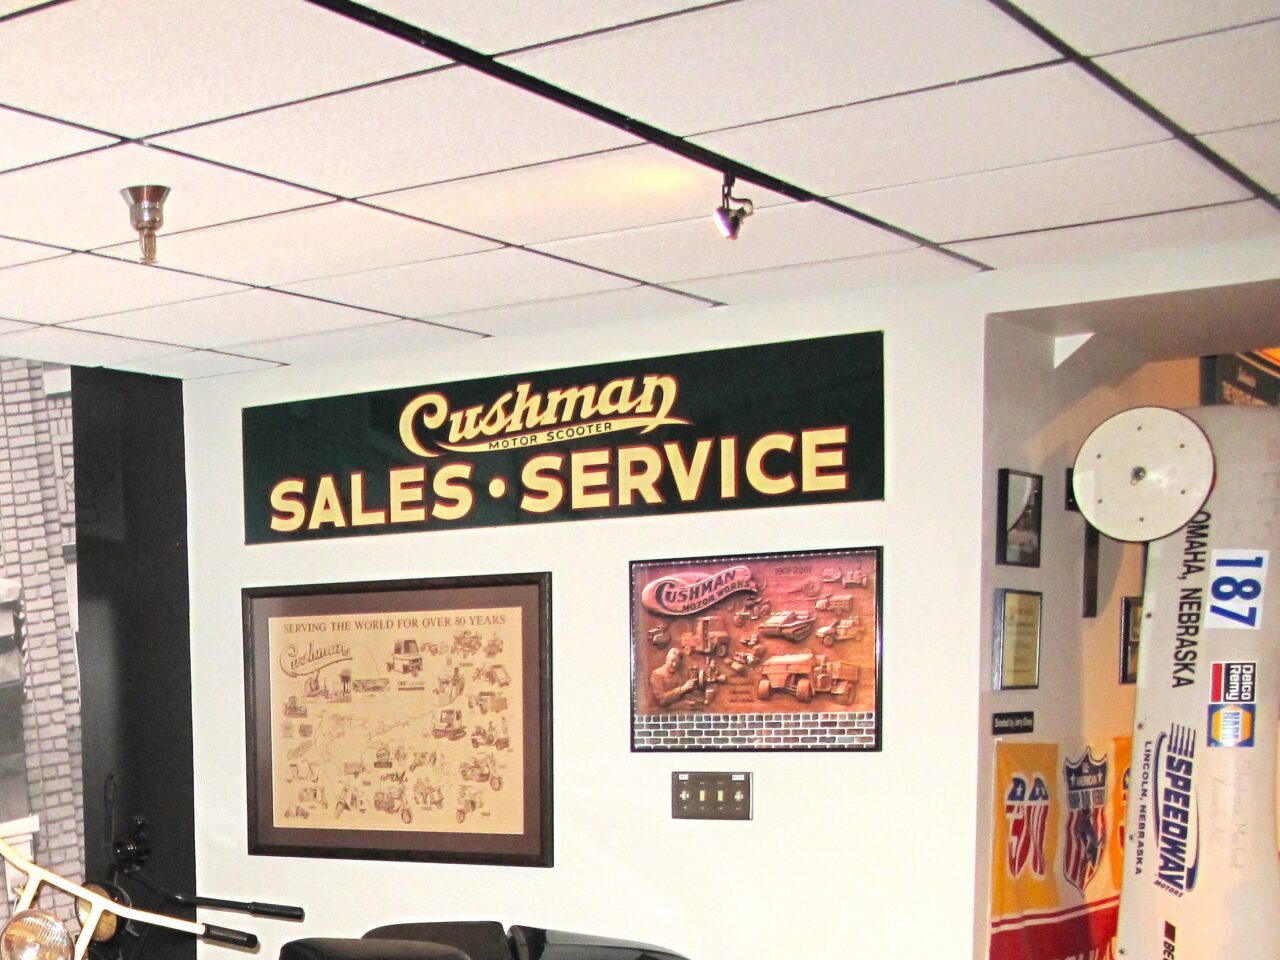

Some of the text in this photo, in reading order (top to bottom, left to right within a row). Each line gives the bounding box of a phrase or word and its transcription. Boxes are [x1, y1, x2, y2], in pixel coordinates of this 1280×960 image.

[399, 373, 693, 458] Cushman
[488, 421, 613, 450] MOTOR SCOOTER
[269, 426, 848, 532] SALES SERVICE
[654, 569, 738, 611] CUSHMAN
[681, 580, 751, 613] MOTOR WORKS
[1172, 510, 1212, 689] OMAHA, NEBRASKA
[1210, 556, 1263, 627] 187
[283, 614, 507, 633] SERVING THE WORLD FOR OVER 80 YEARS
[1226, 664, 1241, 700] Remy
[1241, 664, 1254, 700] Delco
[1135, 741, 1153, 875] LINCOLN, NEBRASKA
[1158, 755, 1193, 890] SPEEDWAY
[1154, 879, 1184, 898] MOTORS
